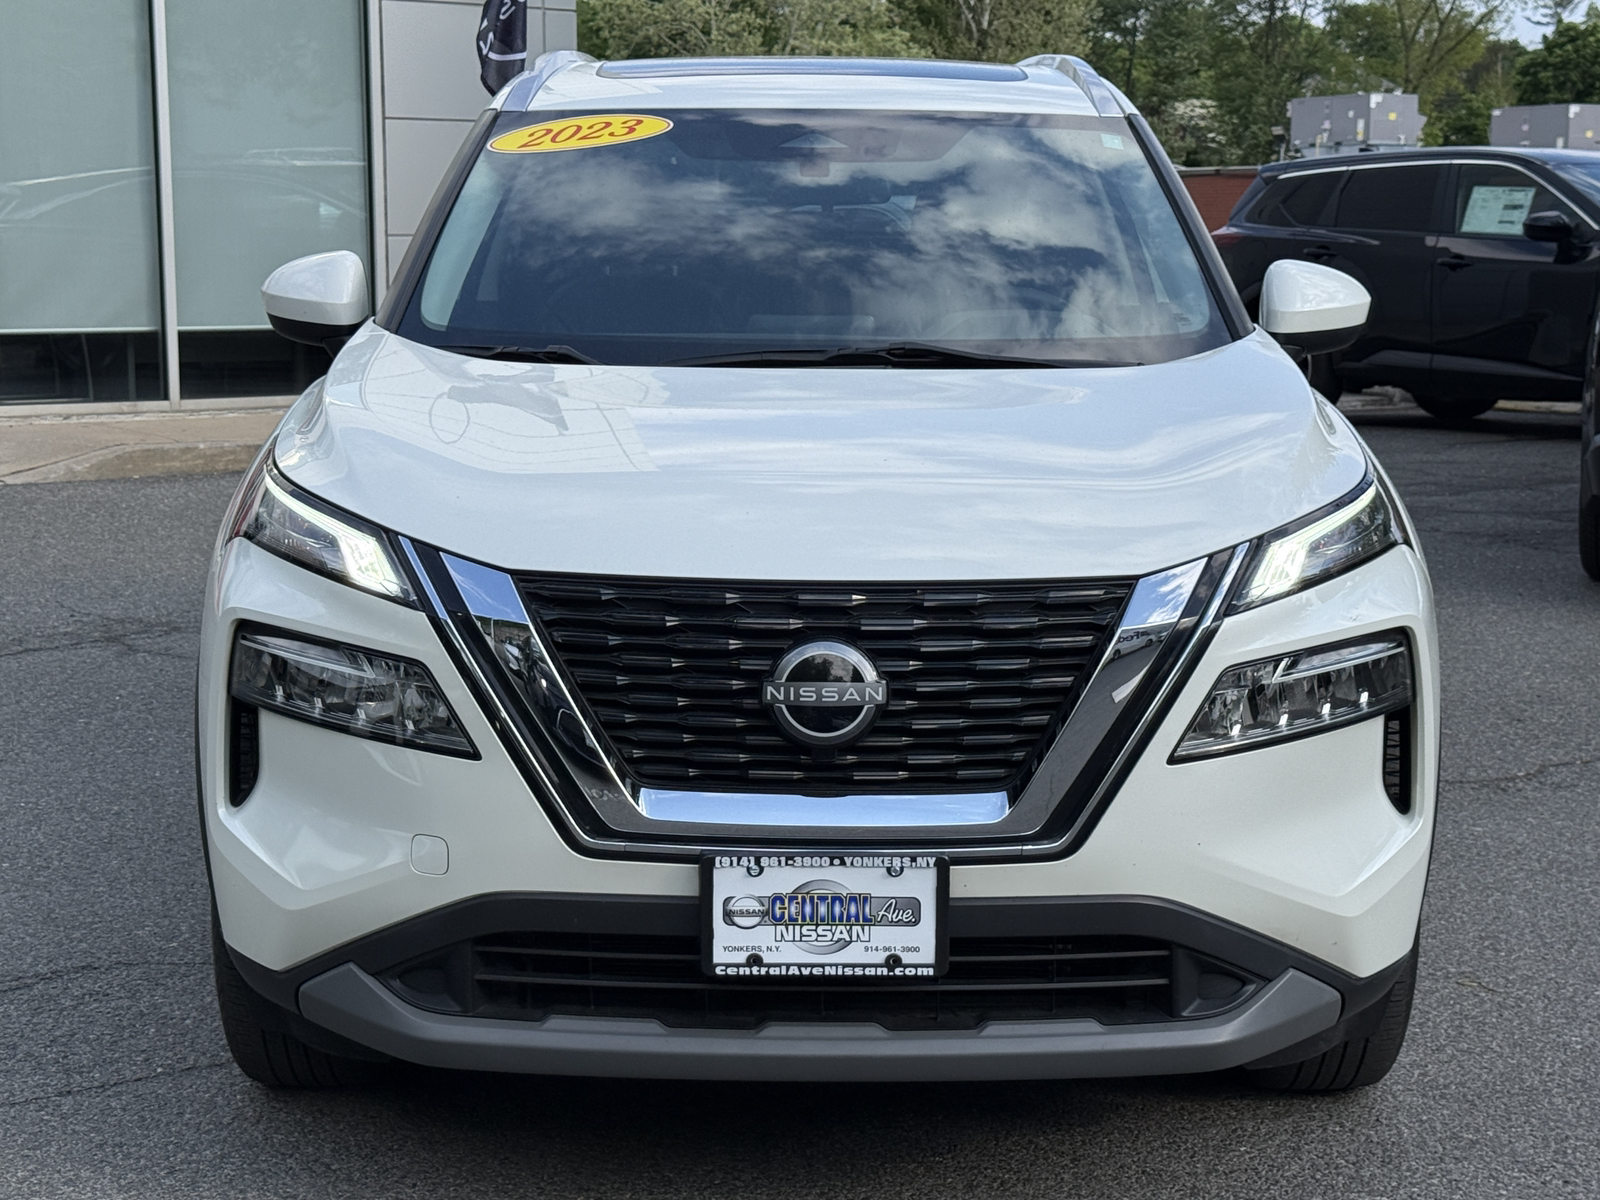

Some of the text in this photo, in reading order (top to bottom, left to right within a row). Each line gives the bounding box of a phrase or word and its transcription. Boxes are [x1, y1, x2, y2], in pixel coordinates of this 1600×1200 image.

[517, 119, 644, 148] 2023
[766, 686, 883, 701] NISSAN
[769, 892, 917, 926] CENTRAL Ave.
[774, 925, 871, 942] NISSAN
[722, 945, 765, 953] YONKERS,
[863, 945, 921, 953] 914-961-3900
[715, 965, 934, 975] CentralAveNissan.com
